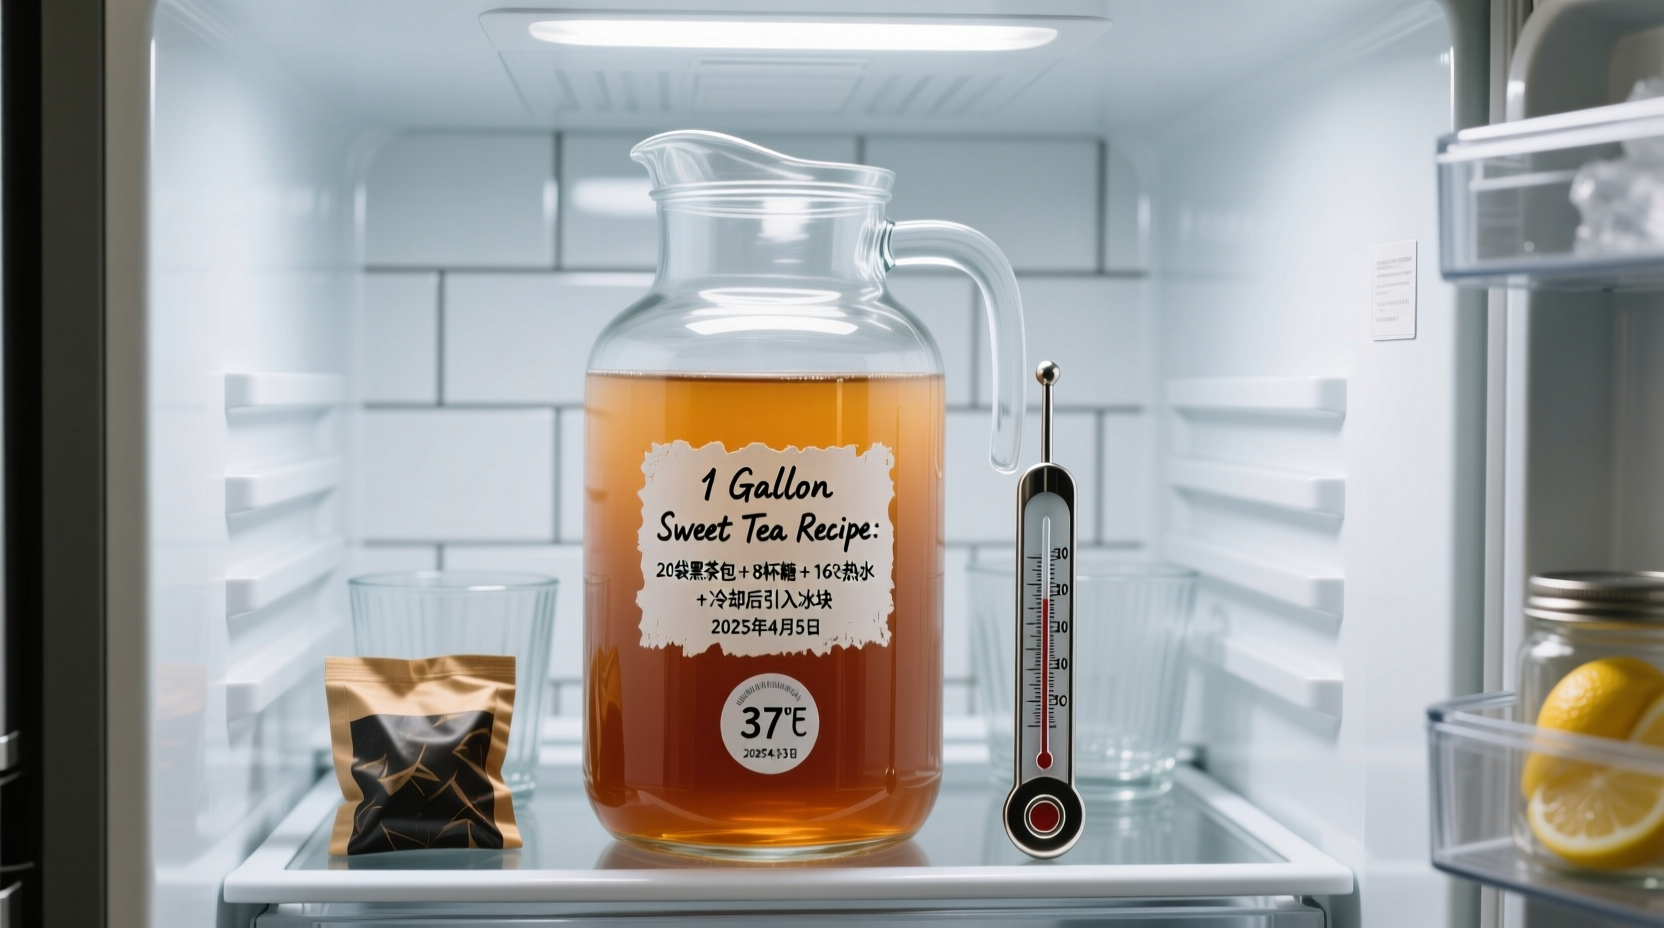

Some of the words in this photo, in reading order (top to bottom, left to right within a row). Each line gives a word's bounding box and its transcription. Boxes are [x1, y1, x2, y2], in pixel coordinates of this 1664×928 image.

[702, 467, 716, 501] 1
[729, 465, 834, 503] Gallon
[657, 511, 733, 542] Sweet
[741, 513, 787, 543] Tea
[796, 512, 880, 553] Recipe:
[711, 617, 820, 637] 2025年4月5日
